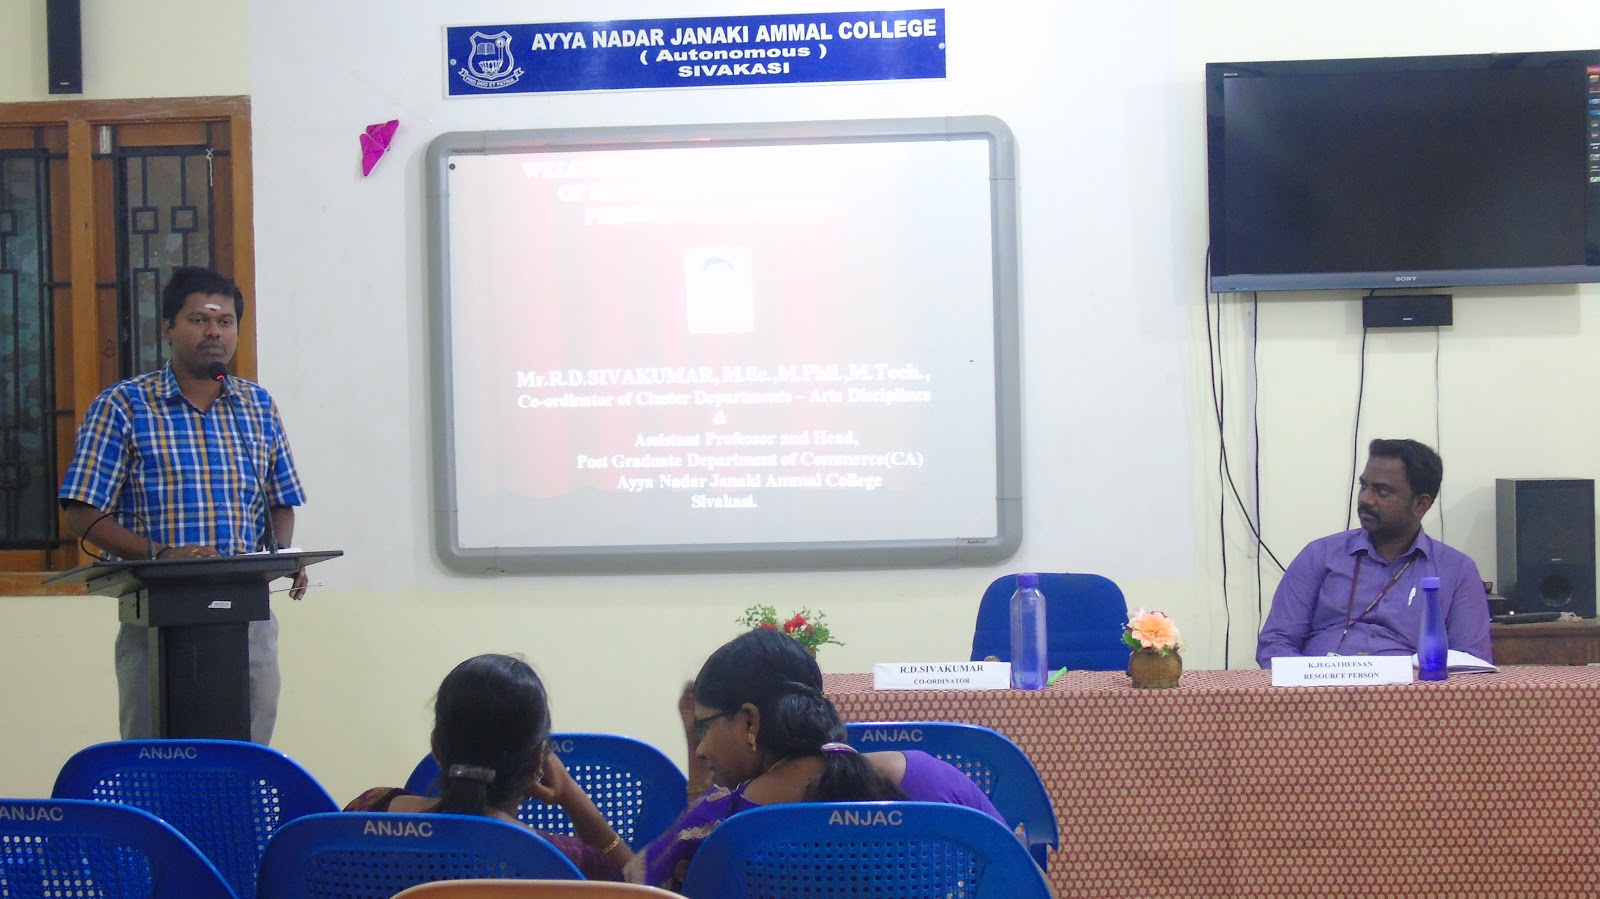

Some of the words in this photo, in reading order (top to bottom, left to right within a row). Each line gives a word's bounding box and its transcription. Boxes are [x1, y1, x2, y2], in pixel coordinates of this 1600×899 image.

[531, 32, 587, 51] AYYA
[592, 28, 665, 49] NADAR
[670, 25, 749, 46] JANAKI
[755, 22, 833, 43] AMMAL
[838, 18, 937, 40] COLLEGE
[678, 62, 790, 78] SIVAKASI
[517, 393, 614, 408] Co-ordinator
[617, 391, 634, 407] of
[635, 391, 691, 407] Cluster
[695, 389, 793, 408] Departments
[808, 388, 843, 403] Arts
[847, 387, 932, 405] Disciplines
[713, 410, 728, 425] &
[634, 433, 701, 447] Assistant
[705, 431, 777, 446] Professor
[780, 430, 810, 445] and
[813, 430, 860, 447] Head,
[577, 455, 608, 469] Post
[611, 454, 683, 468] Graduate
[687, 452, 778, 471] Department
[780, 452, 799, 467] of
[617, 475, 654, 492] Ayya
[659, 474, 707, 489] Nadar
[710, 473, 762, 488] Janaki
[765, 473, 822, 488] Ammal
[824, 472, 883, 491] College
[691, 494, 758, 509] Sivakasi.
[900, 664, 985, 674] R.D.SIVAKUMAR
[1308, 660, 1374, 669] K.JEGATHEESAN
[1304, 672, 1347, 680] RESOURCE
[1348, 671, 1380, 679] PERSON
[861, 728, 924, 743] ANJAC
[139, 747, 198, 760] ANJAC
[0, 805, 64, 821] ANJAC
[828, 810, 904, 827] ANJAC
[363, 820, 434, 837] ANJAC
